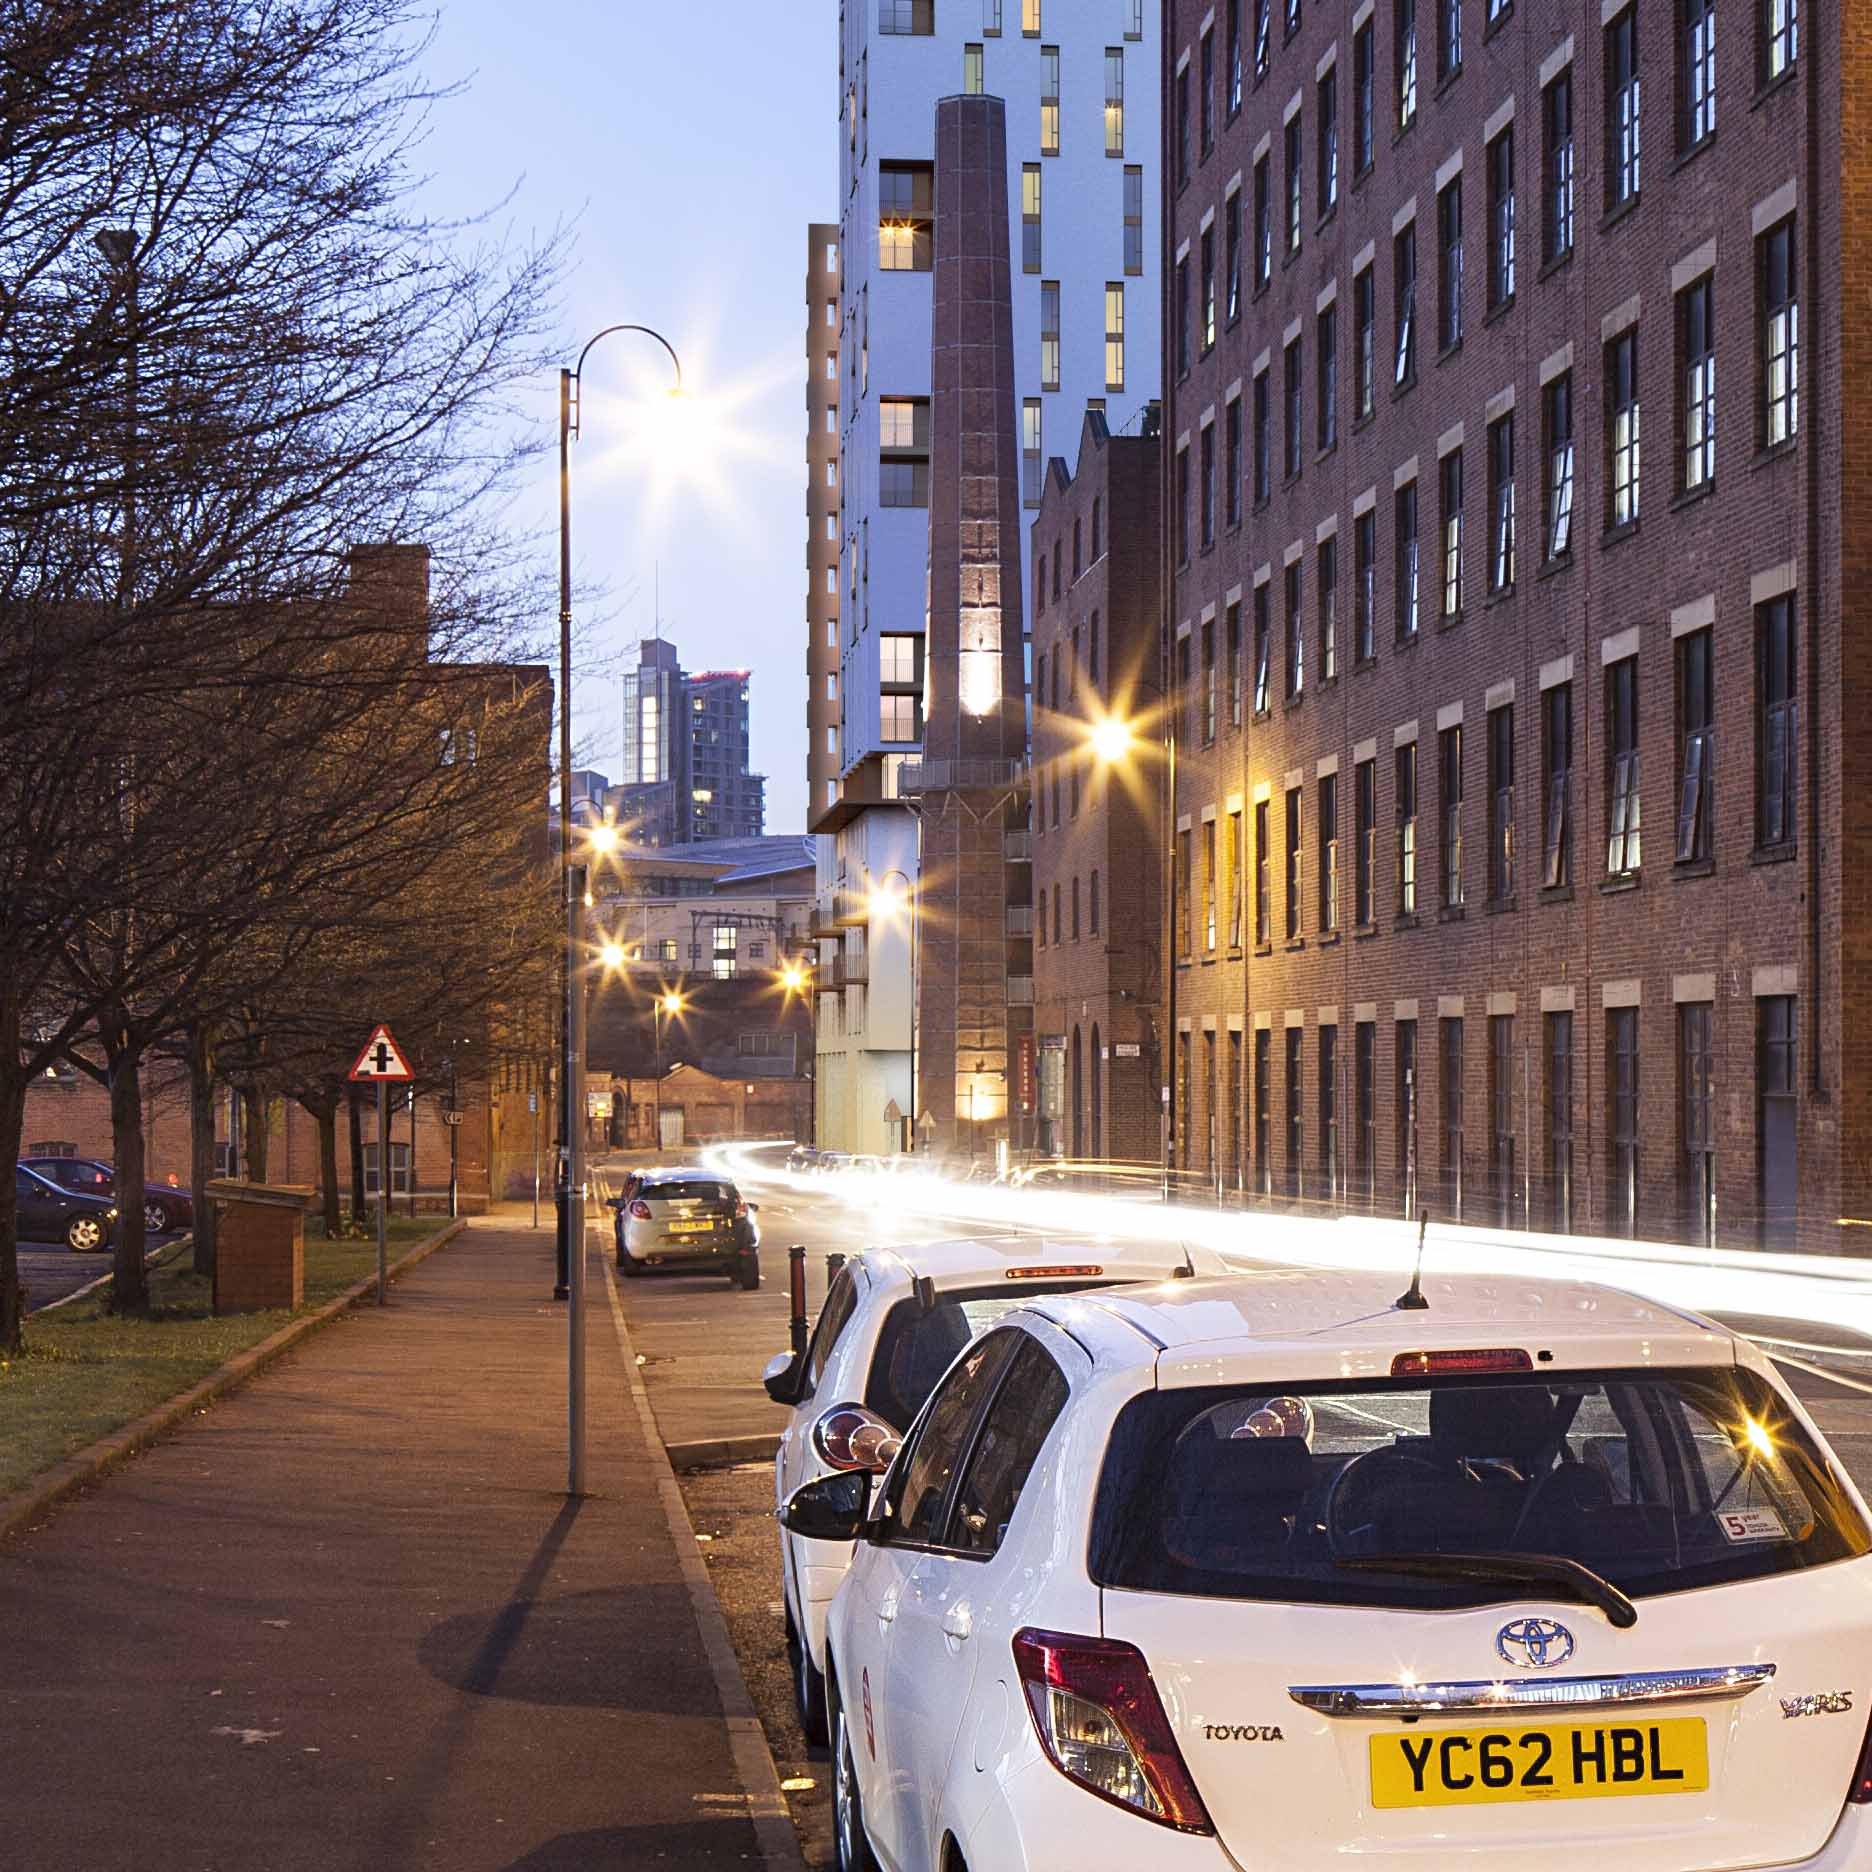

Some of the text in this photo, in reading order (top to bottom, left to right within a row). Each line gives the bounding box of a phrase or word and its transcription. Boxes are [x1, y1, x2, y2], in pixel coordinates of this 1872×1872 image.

[1725, 1516, 1746, 1536] 5
[1779, 1690, 1853, 1720] YARIS
[1202, 1725, 1284, 1741] TOYOTA
[1399, 1727, 1684, 1792] YC62 HBL
